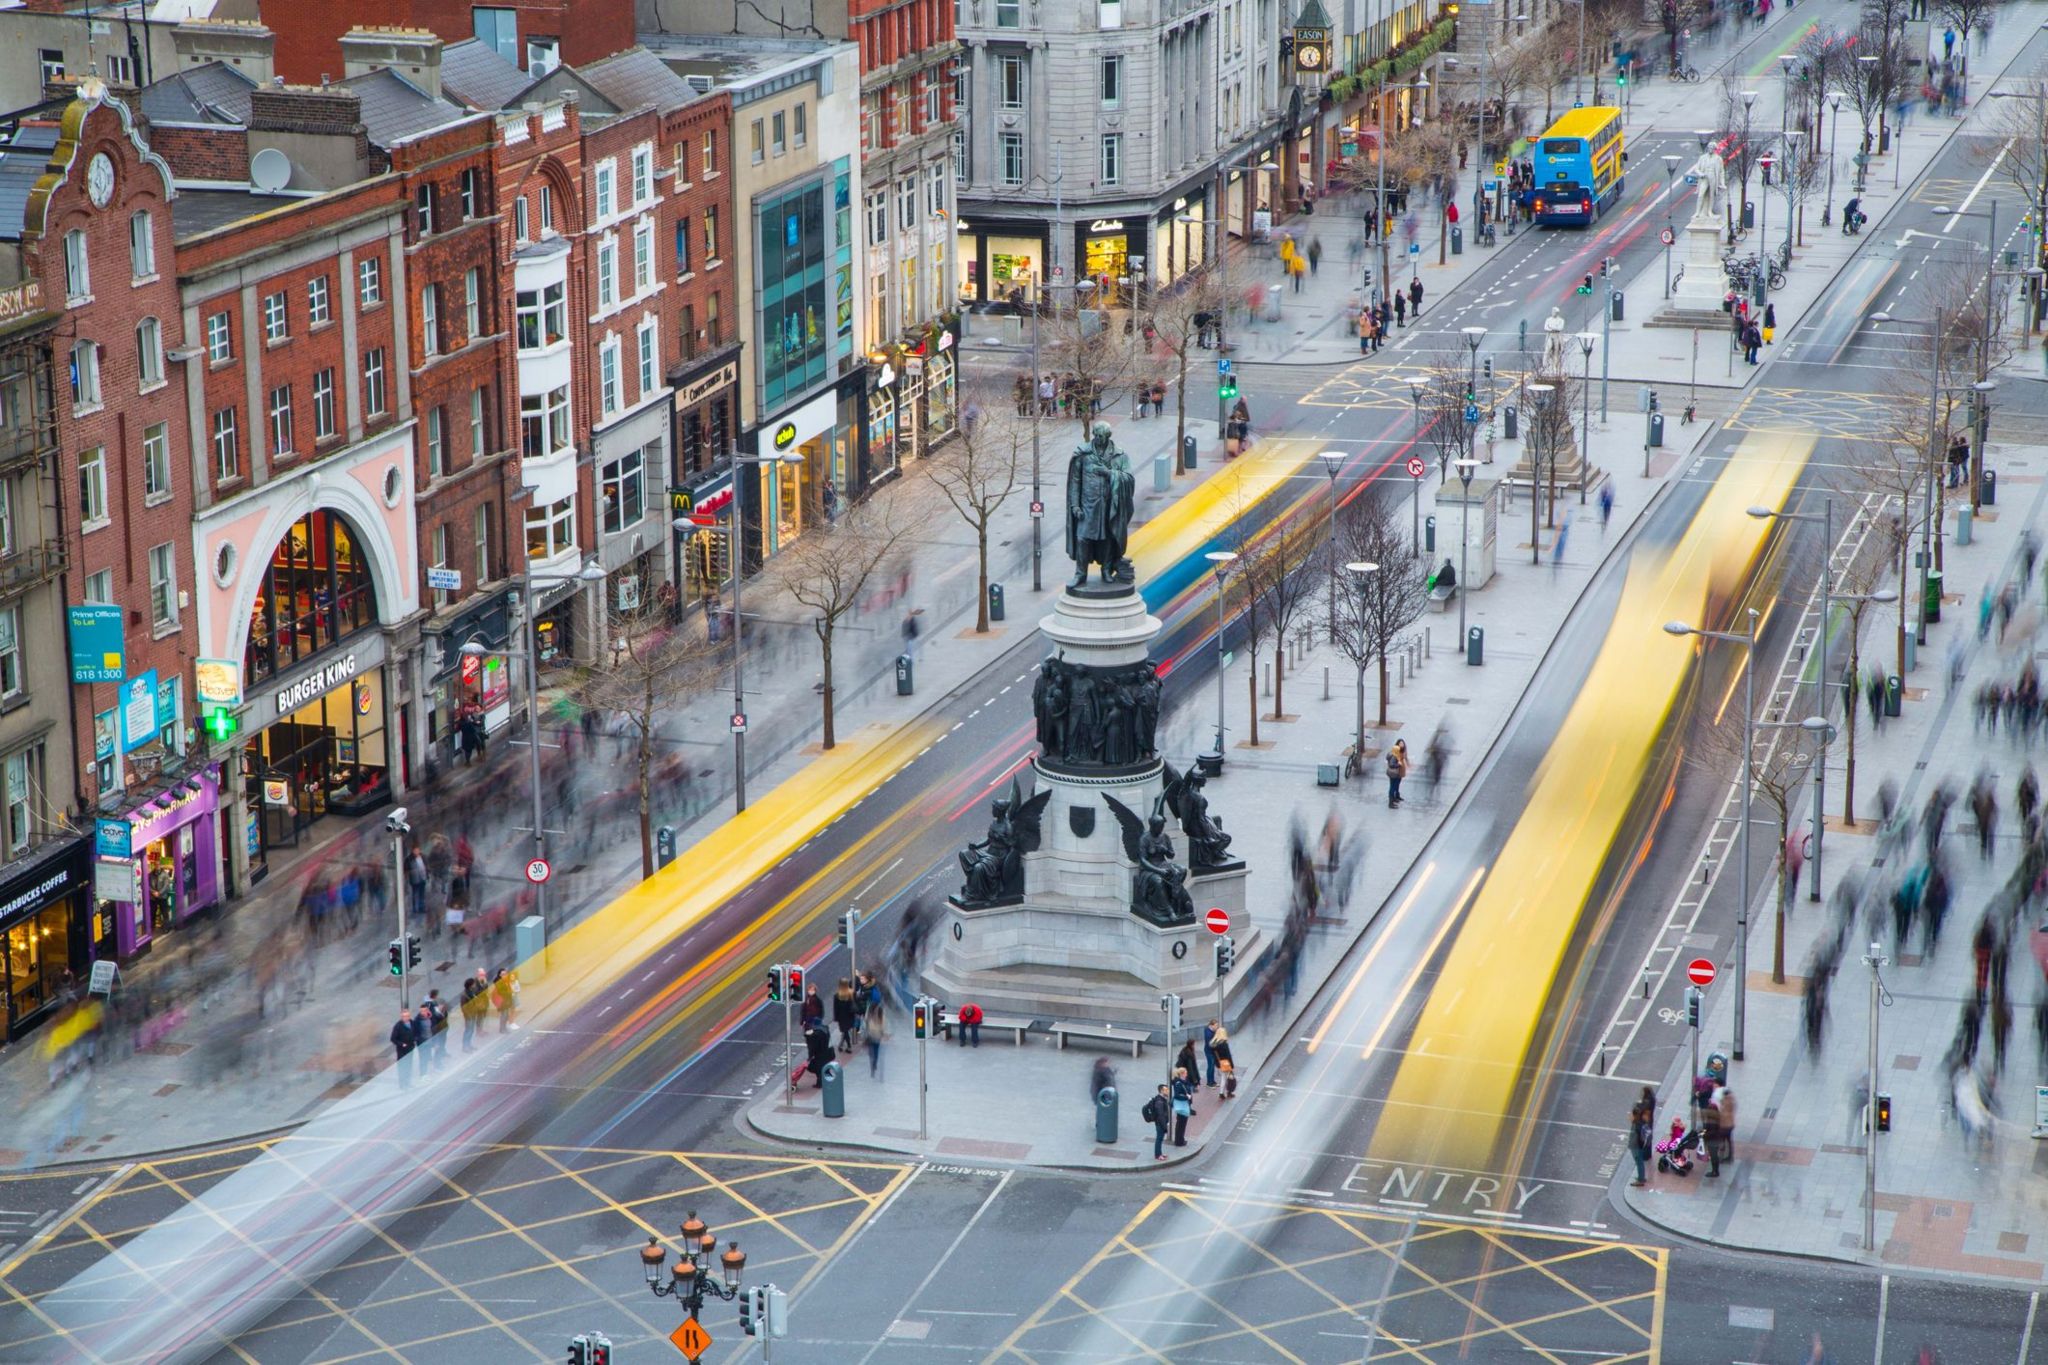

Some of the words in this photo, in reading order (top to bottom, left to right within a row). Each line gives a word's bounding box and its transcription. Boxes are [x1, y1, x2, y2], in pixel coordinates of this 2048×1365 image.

[1297, 30, 1323, 40] EASON
[75, 670, 96, 680] 618
[98, 669, 122, 679] 1300
[278, 670, 325, 713] BURGER
[326, 654, 355, 686] KING
[199, 679, 238, 700] Heaven
[532, 863, 544, 874] 30
[0, 886, 41, 918] STARBUCKS
[41, 870, 68, 893] COFFEE
[926, 1164, 971, 1175] RIGHT
[973, 1168, 1010, 1177] LOOK
[1340, 1162, 1546, 1211] ENTRY
